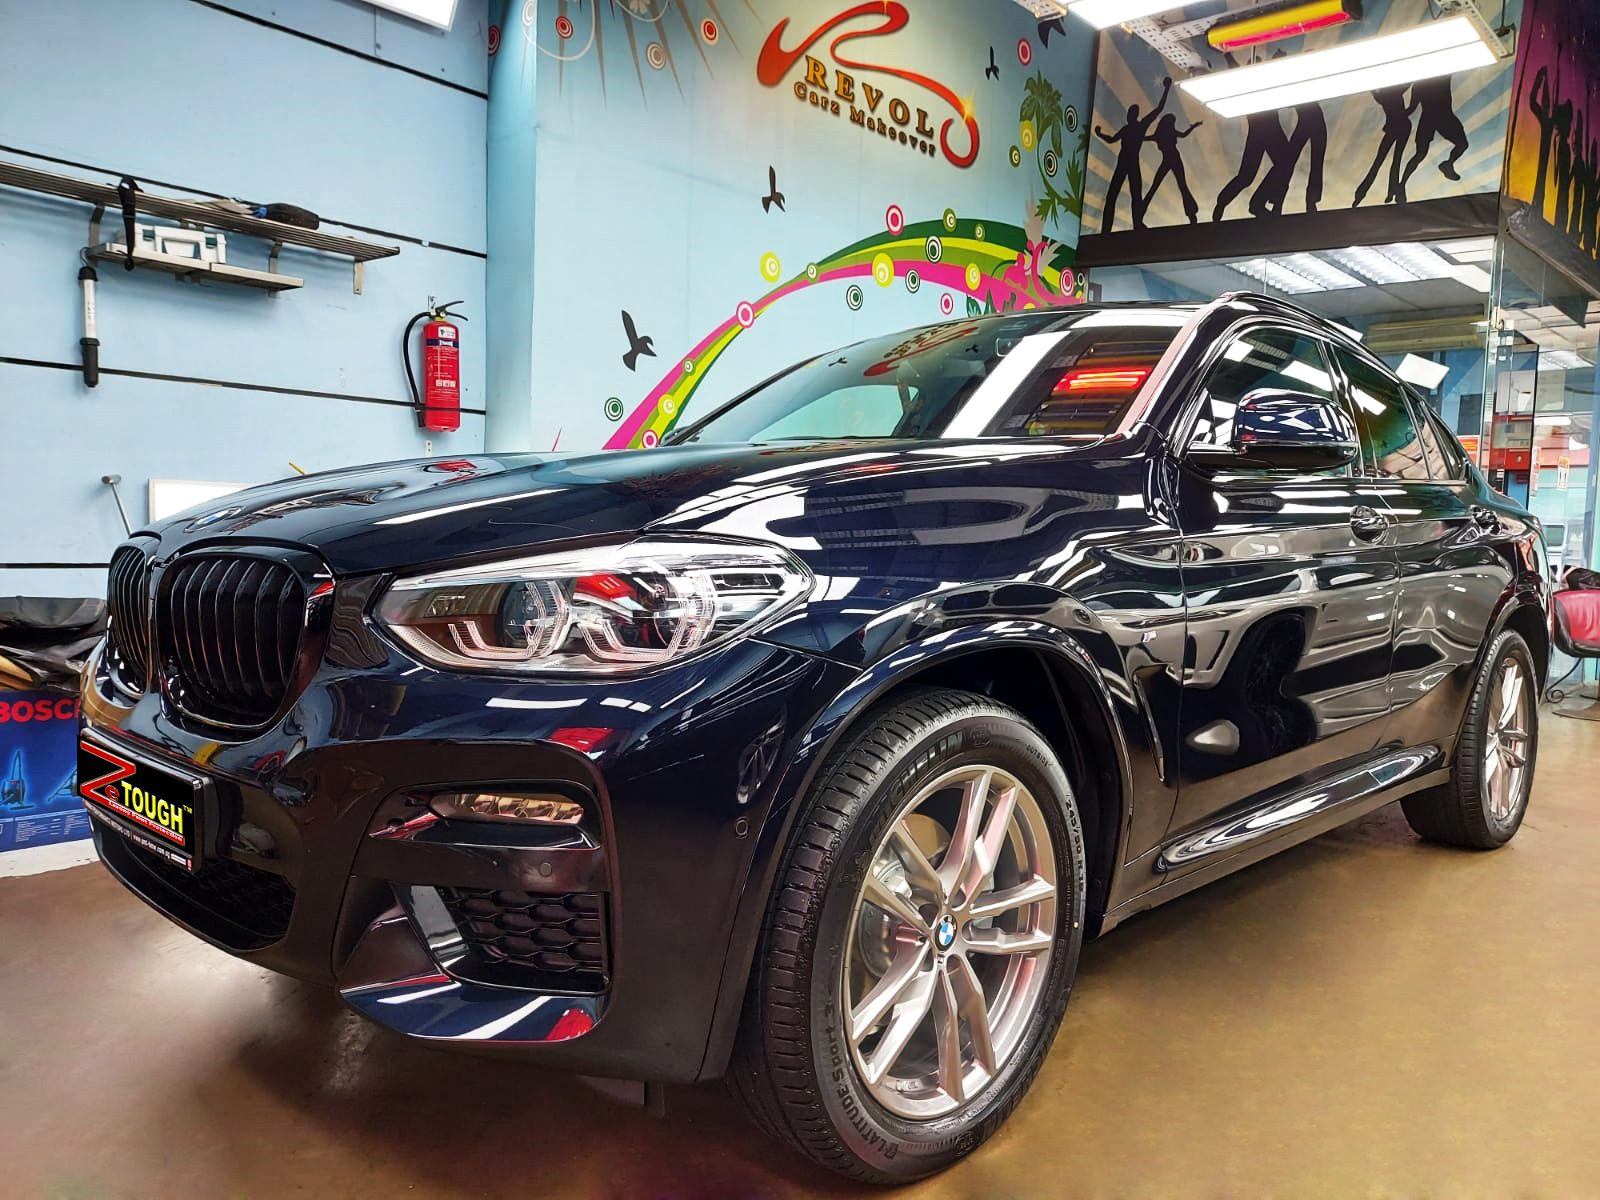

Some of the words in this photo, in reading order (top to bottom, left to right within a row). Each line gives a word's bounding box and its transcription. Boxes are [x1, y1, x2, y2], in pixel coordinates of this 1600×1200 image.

[794, 81, 841, 116] Carz
[849, 105, 936, 157] Makeover
[825, 1024, 845, 1083] Sport
[837, 1084, 891, 1157] LATITUDE
